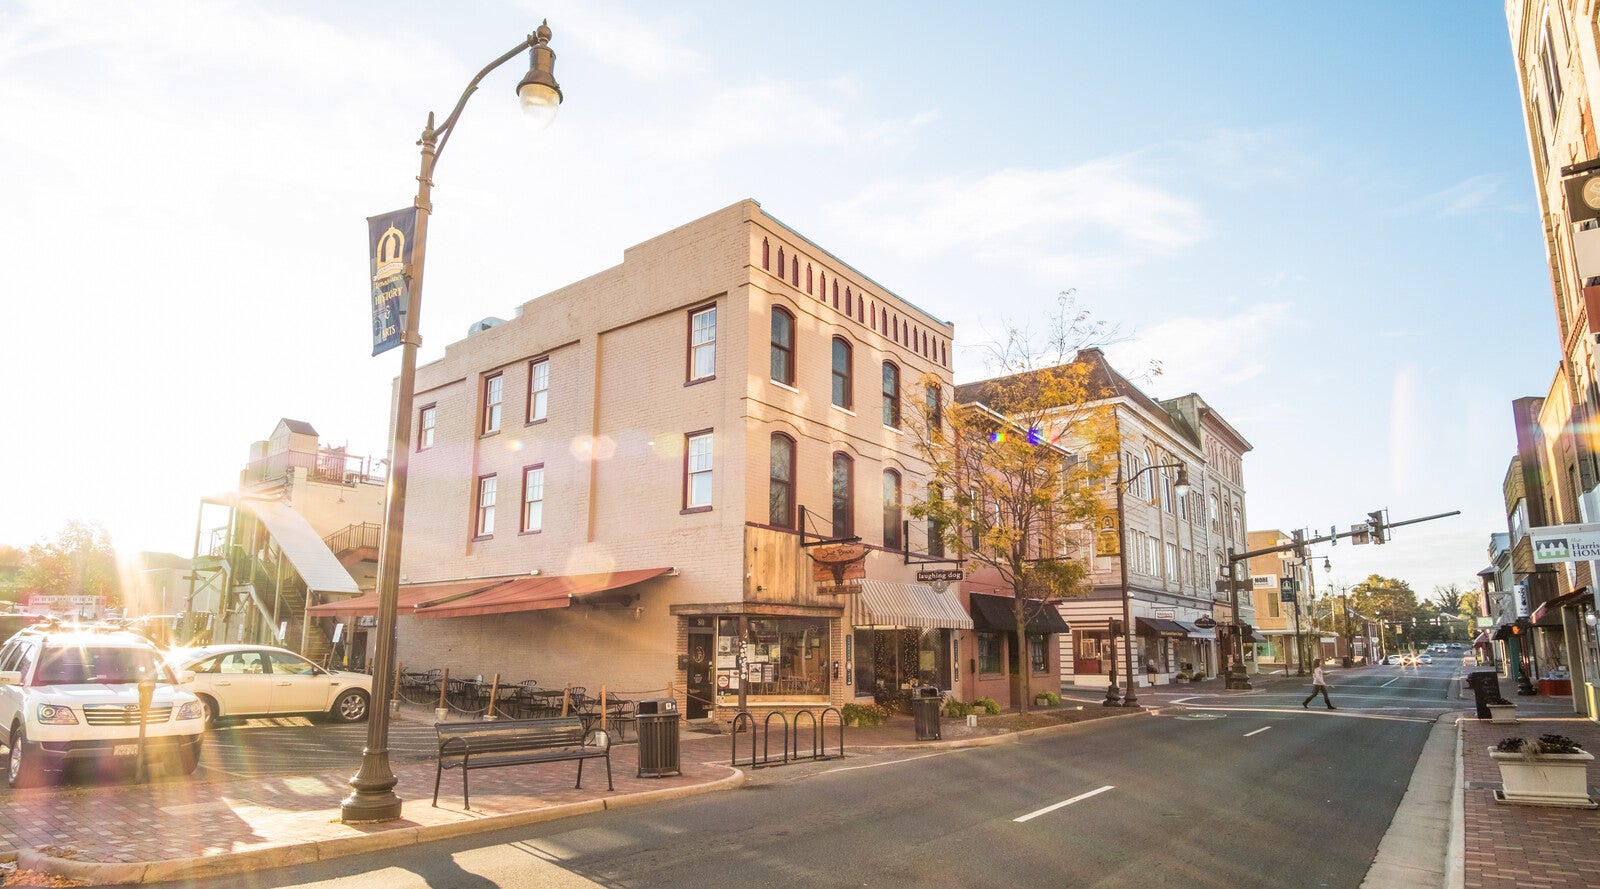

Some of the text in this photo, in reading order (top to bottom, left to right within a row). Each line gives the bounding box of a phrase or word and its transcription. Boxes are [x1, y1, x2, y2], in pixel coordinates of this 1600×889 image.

[375, 287, 402, 305] HISTORY
[382, 325, 396, 339] ARTS
[918, 571, 961, 580] laughing dog
